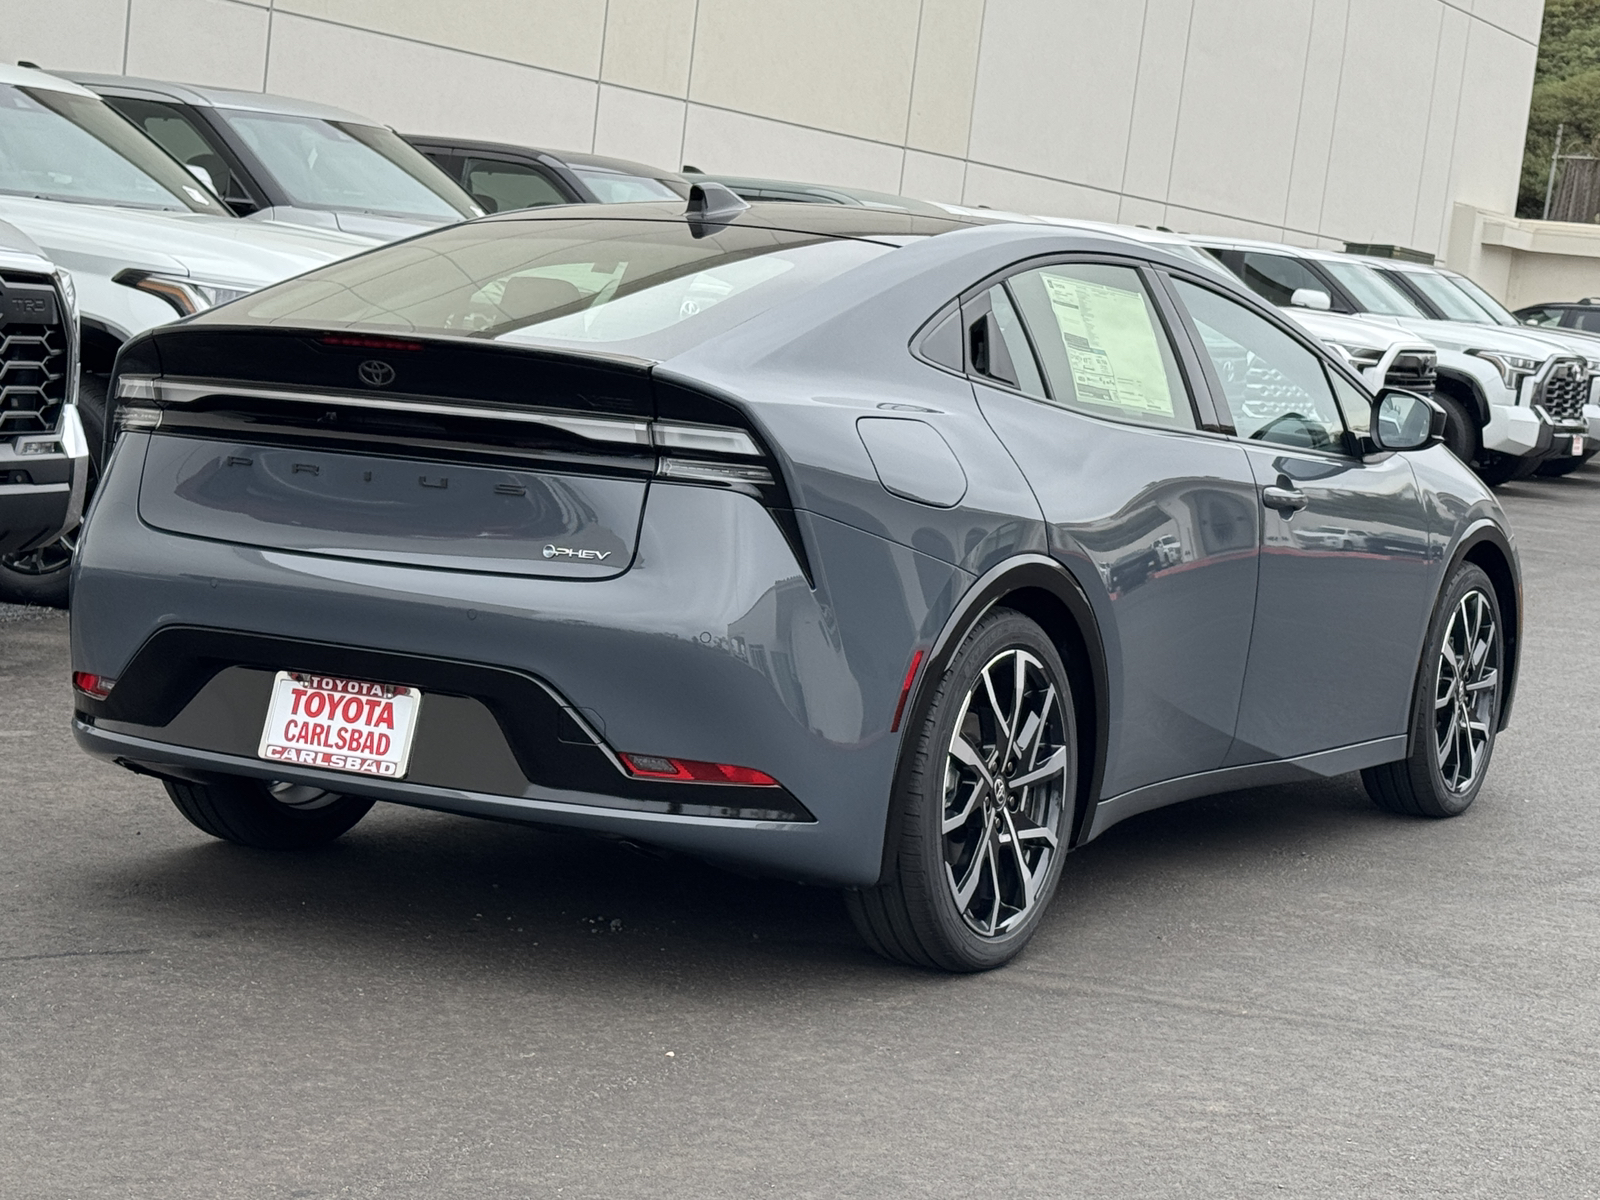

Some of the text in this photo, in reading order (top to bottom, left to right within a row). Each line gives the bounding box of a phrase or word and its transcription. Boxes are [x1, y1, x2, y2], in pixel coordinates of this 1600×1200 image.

[12, 298, 46, 312] TRD
[227, 455, 527, 497] PRIUS
[556, 547, 612, 561] PHEV
[311, 676, 383, 697] TOYOTA
[290, 688, 395, 730] TOYOTA
[283, 719, 392, 756] CARLSBAD
[266, 745, 396, 776] CARLSBAD
